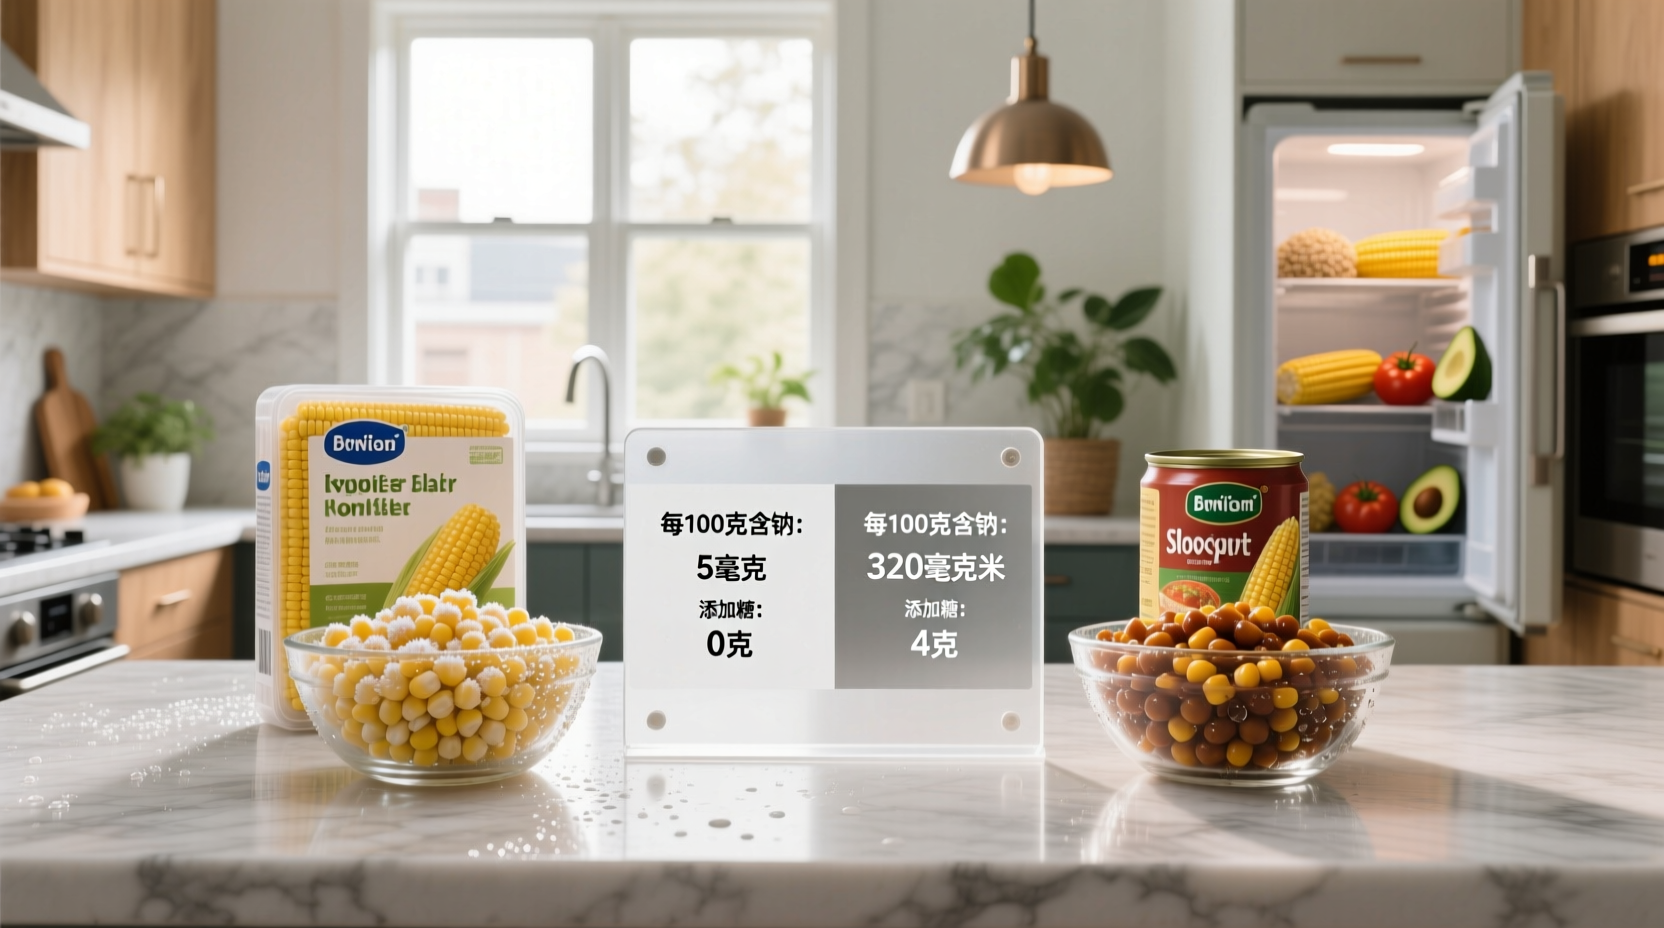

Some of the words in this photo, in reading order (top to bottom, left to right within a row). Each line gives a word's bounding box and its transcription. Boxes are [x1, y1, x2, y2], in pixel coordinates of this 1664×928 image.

[661, 511, 802, 536] 每100克含钠：
[864, 511, 1007, 536] 每100克含钠：
[697, 554, 767, 581] 5毫克
[867, 552, 1006, 582] 320毫克米
[707, 630, 753, 658] 0克
[911, 629, 958, 659] 4克
